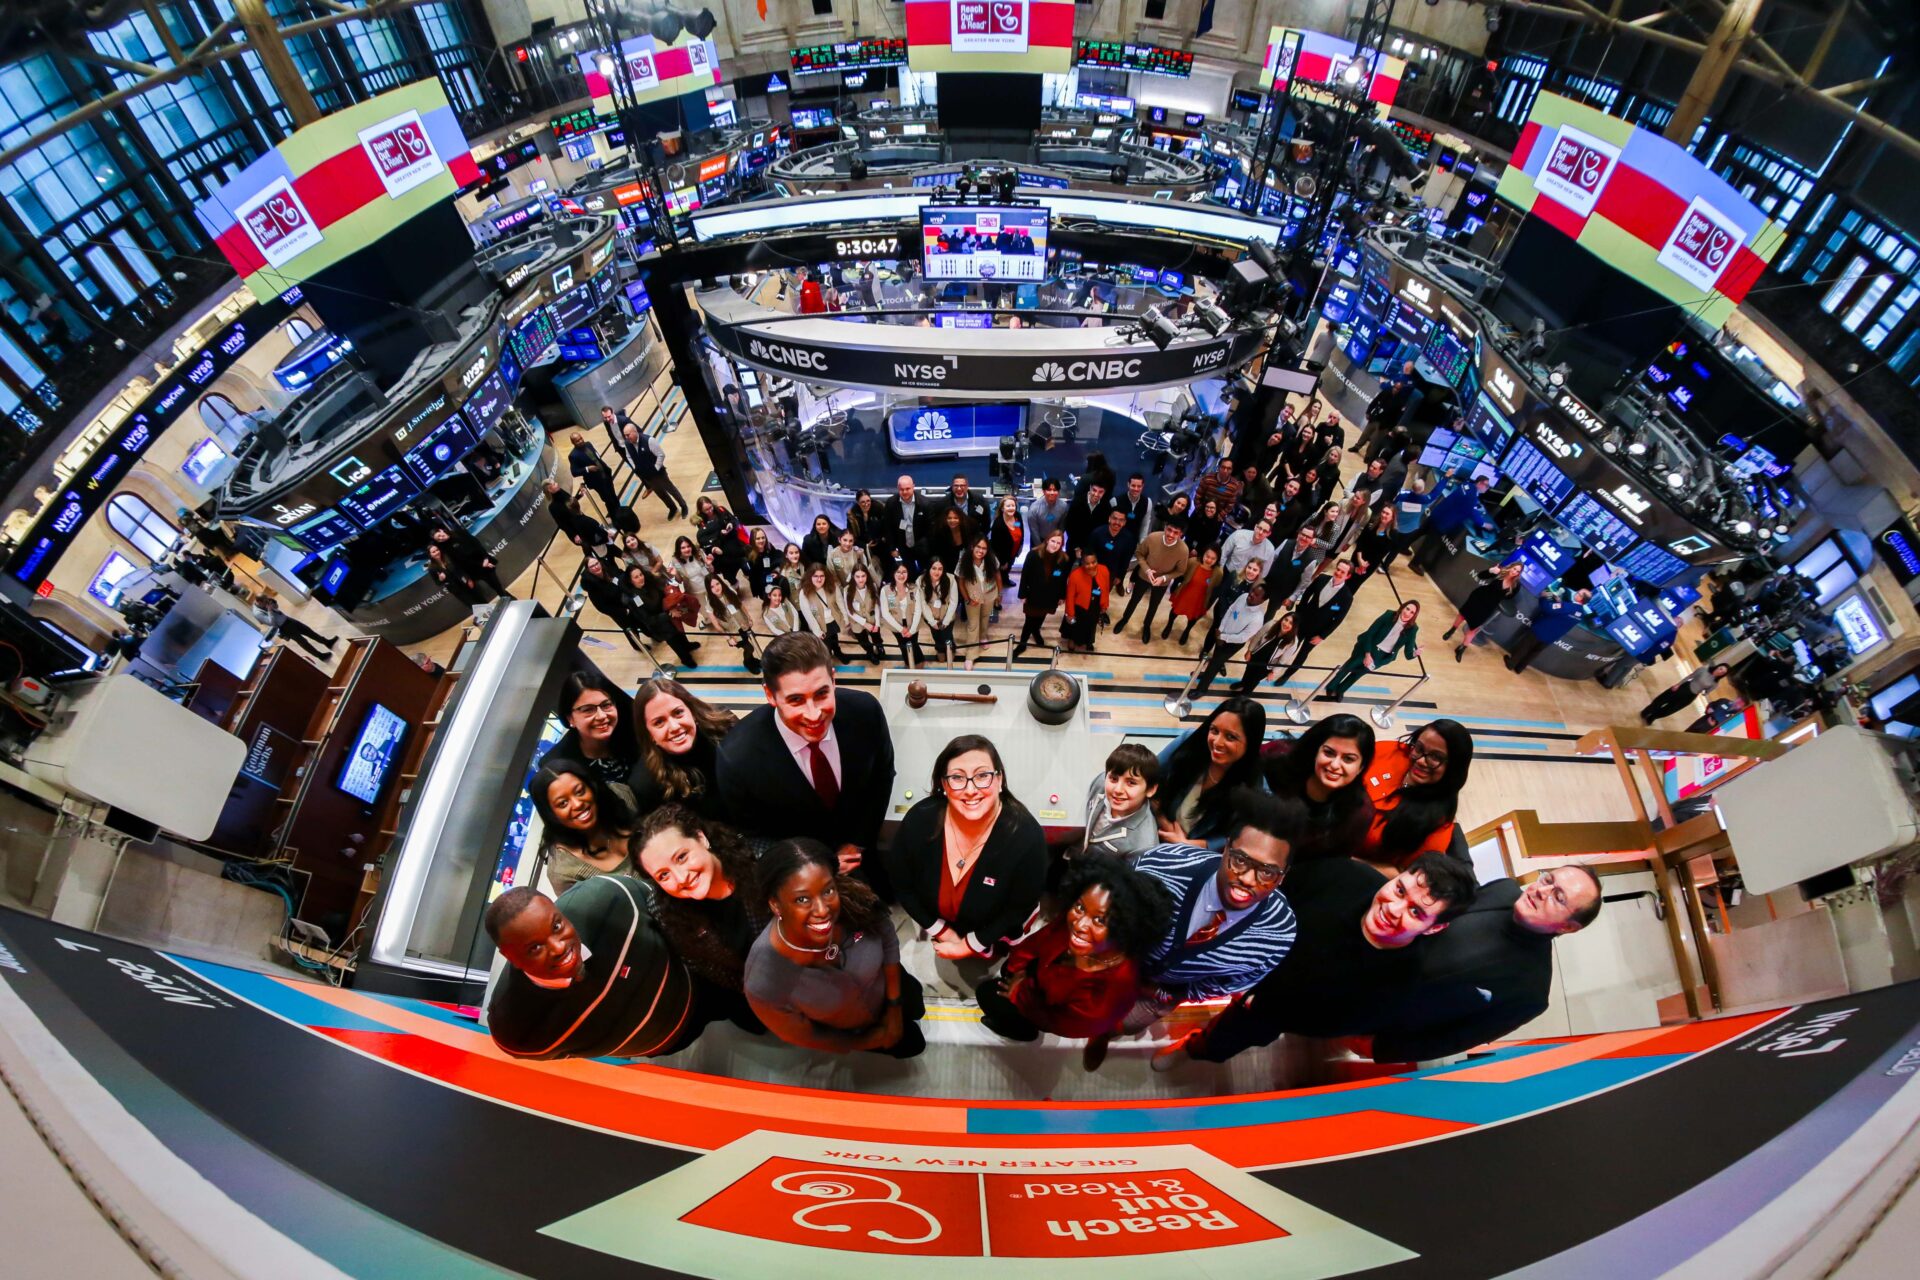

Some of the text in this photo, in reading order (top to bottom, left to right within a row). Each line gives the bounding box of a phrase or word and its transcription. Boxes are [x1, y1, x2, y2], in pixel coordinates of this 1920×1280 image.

[960, 4, 984, 13] Reach
[496, 210, 527, 230] LIVE ON
[836, 238, 898, 256] 9:30:47
[220, 333, 245, 354] NYSE
[768, 344, 829, 371] CNBC
[185, 359, 213, 383] NYSE
[463, 357, 486, 387] NYSE
[1067, 358, 1142, 382] CNBC
[1559, 395, 1603, 433] 9:30:47
[121, 423, 149, 451] NYSE
[914, 429, 953, 441] CNBC
[1536, 422, 1572, 458] NYSE
[519, 490, 547, 526] NEW YORK
[1596, 488, 1620, 507] CITADEL
[53, 501, 81, 533] NYSE
[403, 592, 445, 617] NEW YORK
[244, 727, 272, 772] Goldman
[254, 745, 273, 777] Sachs
[823, 1149, 1139, 1168] GREATER NEW YORK
[1147, 1178, 1184, 1193] &
[1110, 1193, 1209, 1215] Out
[1046, 1210, 1239, 1241] Reach
